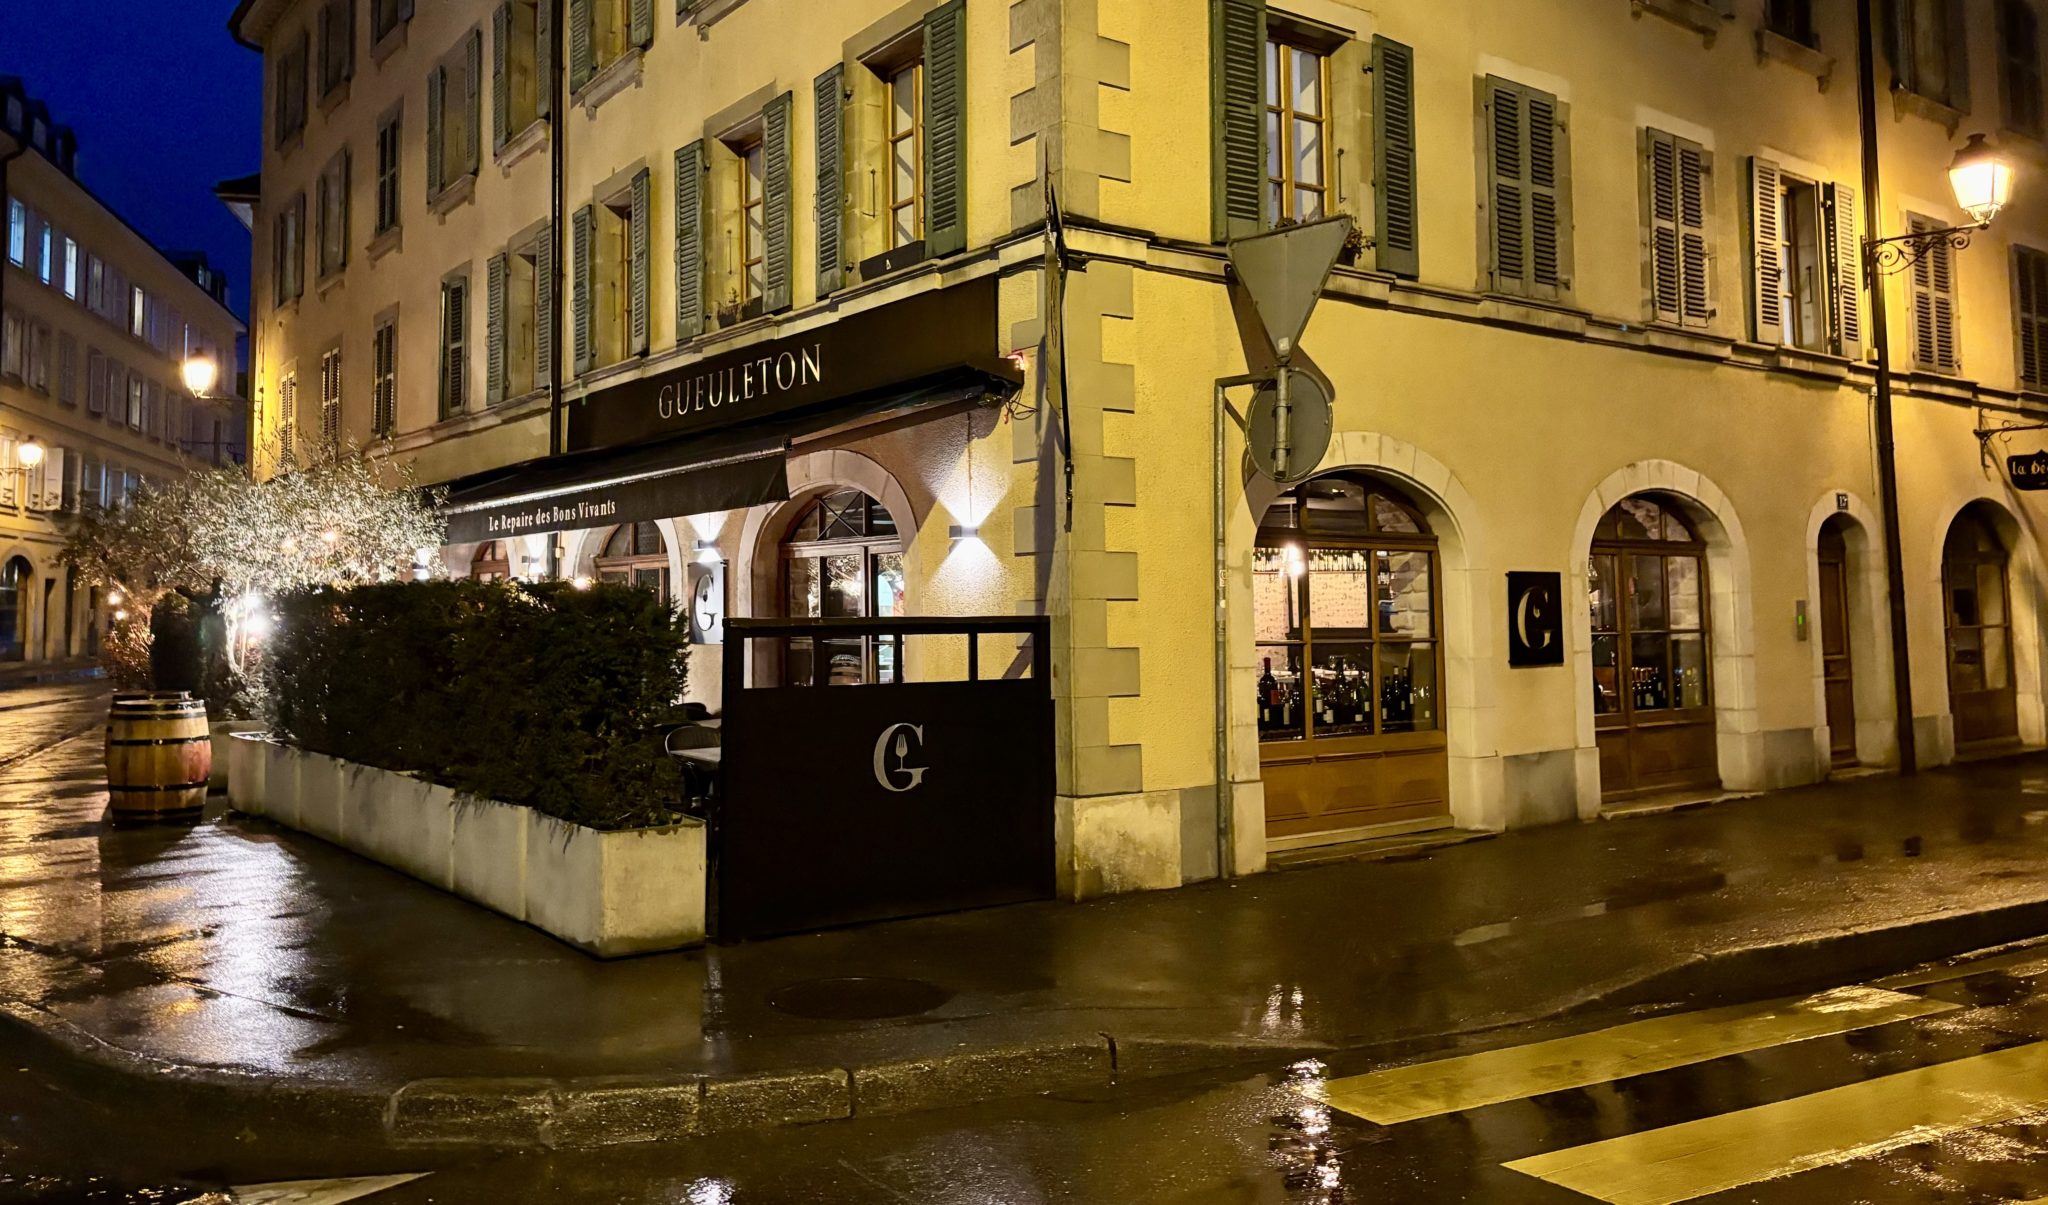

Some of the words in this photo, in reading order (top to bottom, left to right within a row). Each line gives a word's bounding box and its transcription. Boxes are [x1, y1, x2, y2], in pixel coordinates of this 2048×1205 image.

[658, 343, 822, 420] GUEULETON
[488, 516, 499, 532] Le
[501, 511, 533, 533] Repaire
[535, 508, 551, 525] des
[553, 506, 577, 522] Bons
[578, 499, 616, 519] Vivants
[694, 574, 718, 632] G
[873, 722, 930, 792] G
